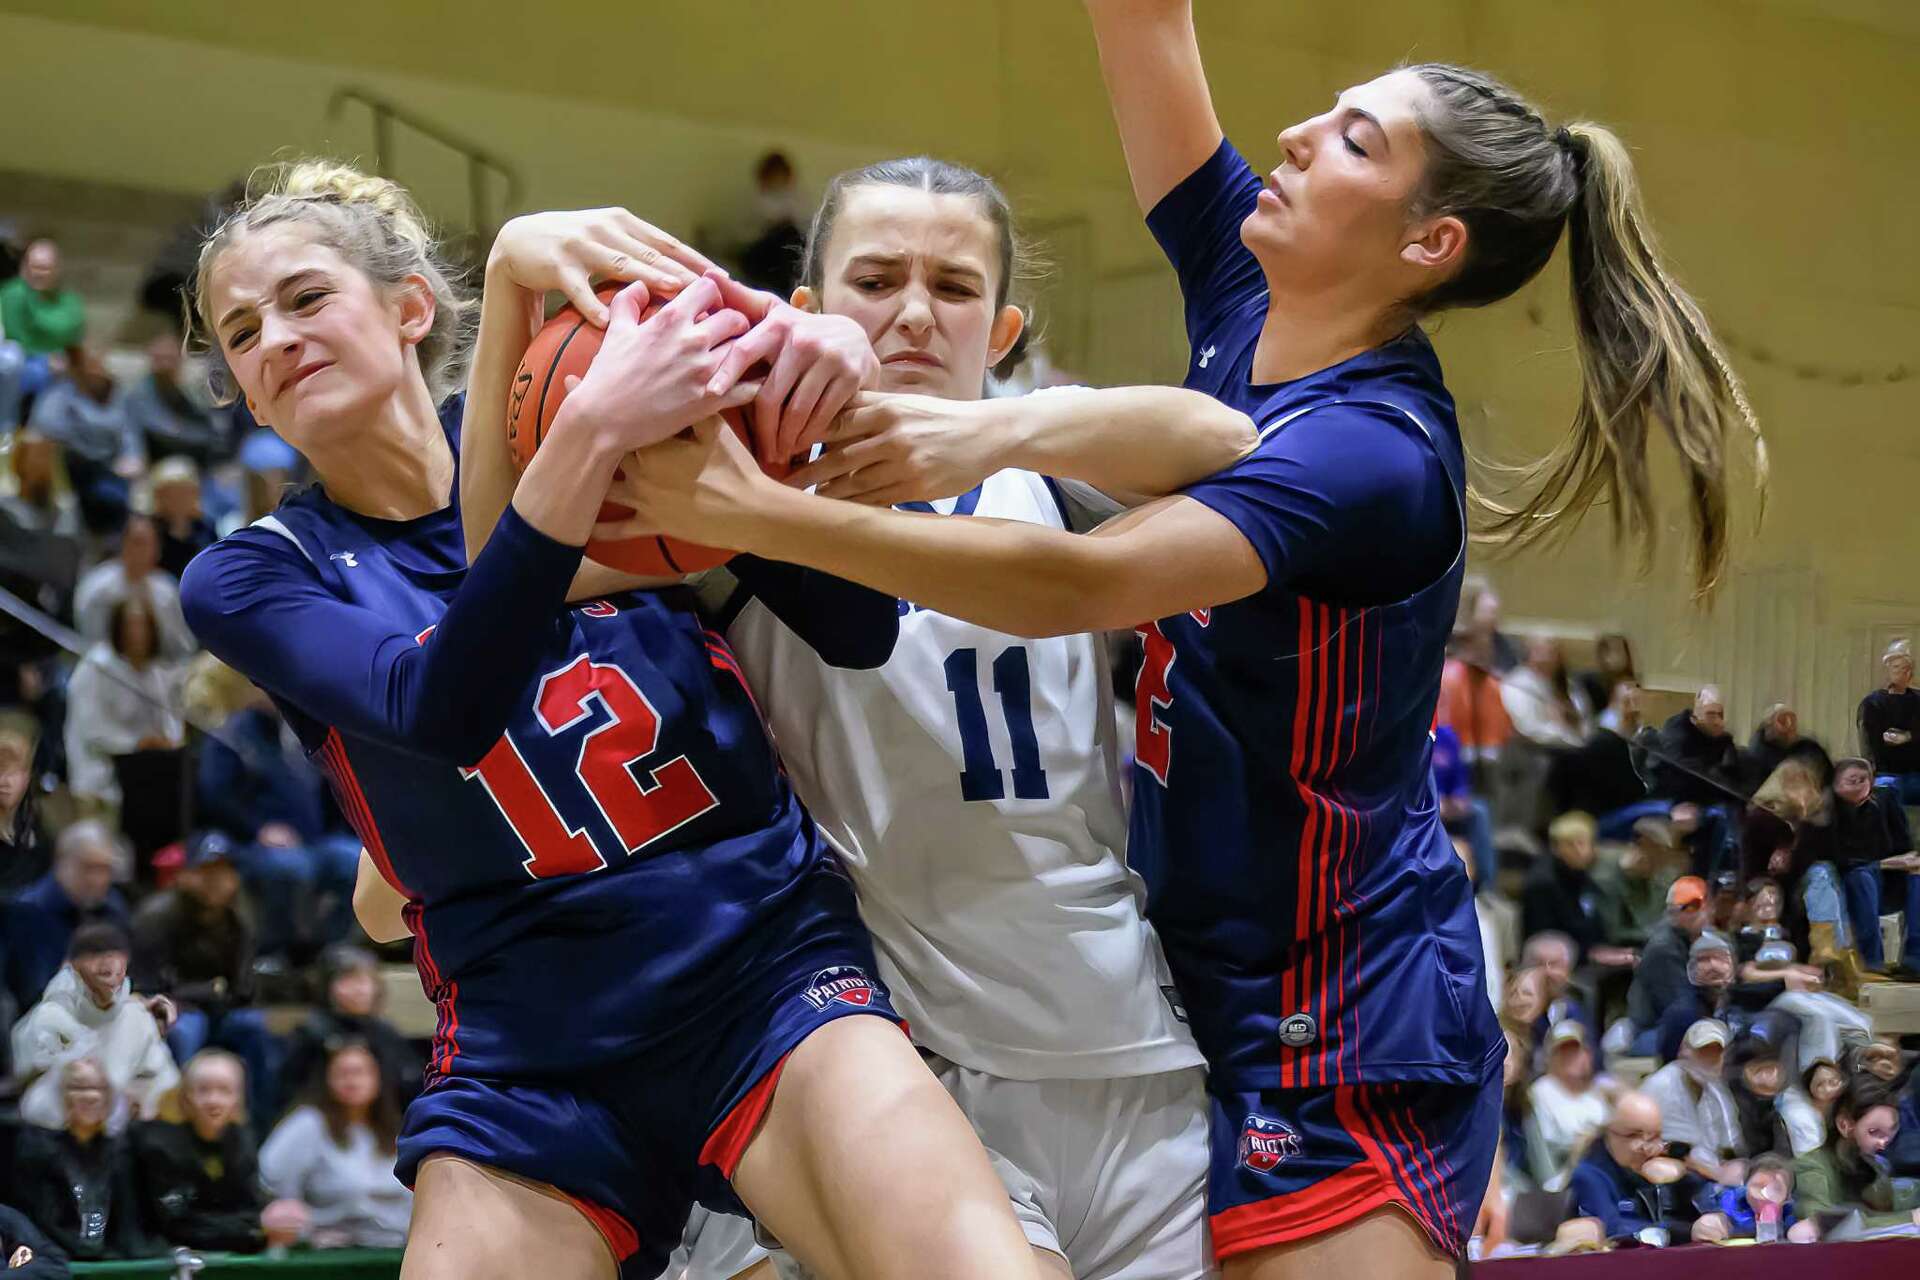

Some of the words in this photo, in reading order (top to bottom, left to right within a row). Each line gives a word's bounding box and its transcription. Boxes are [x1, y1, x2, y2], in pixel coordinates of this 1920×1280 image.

[457, 653, 720, 879] 12
[943, 646, 1050, 801] 11
[807, 977, 875, 1005] PATRIOT
